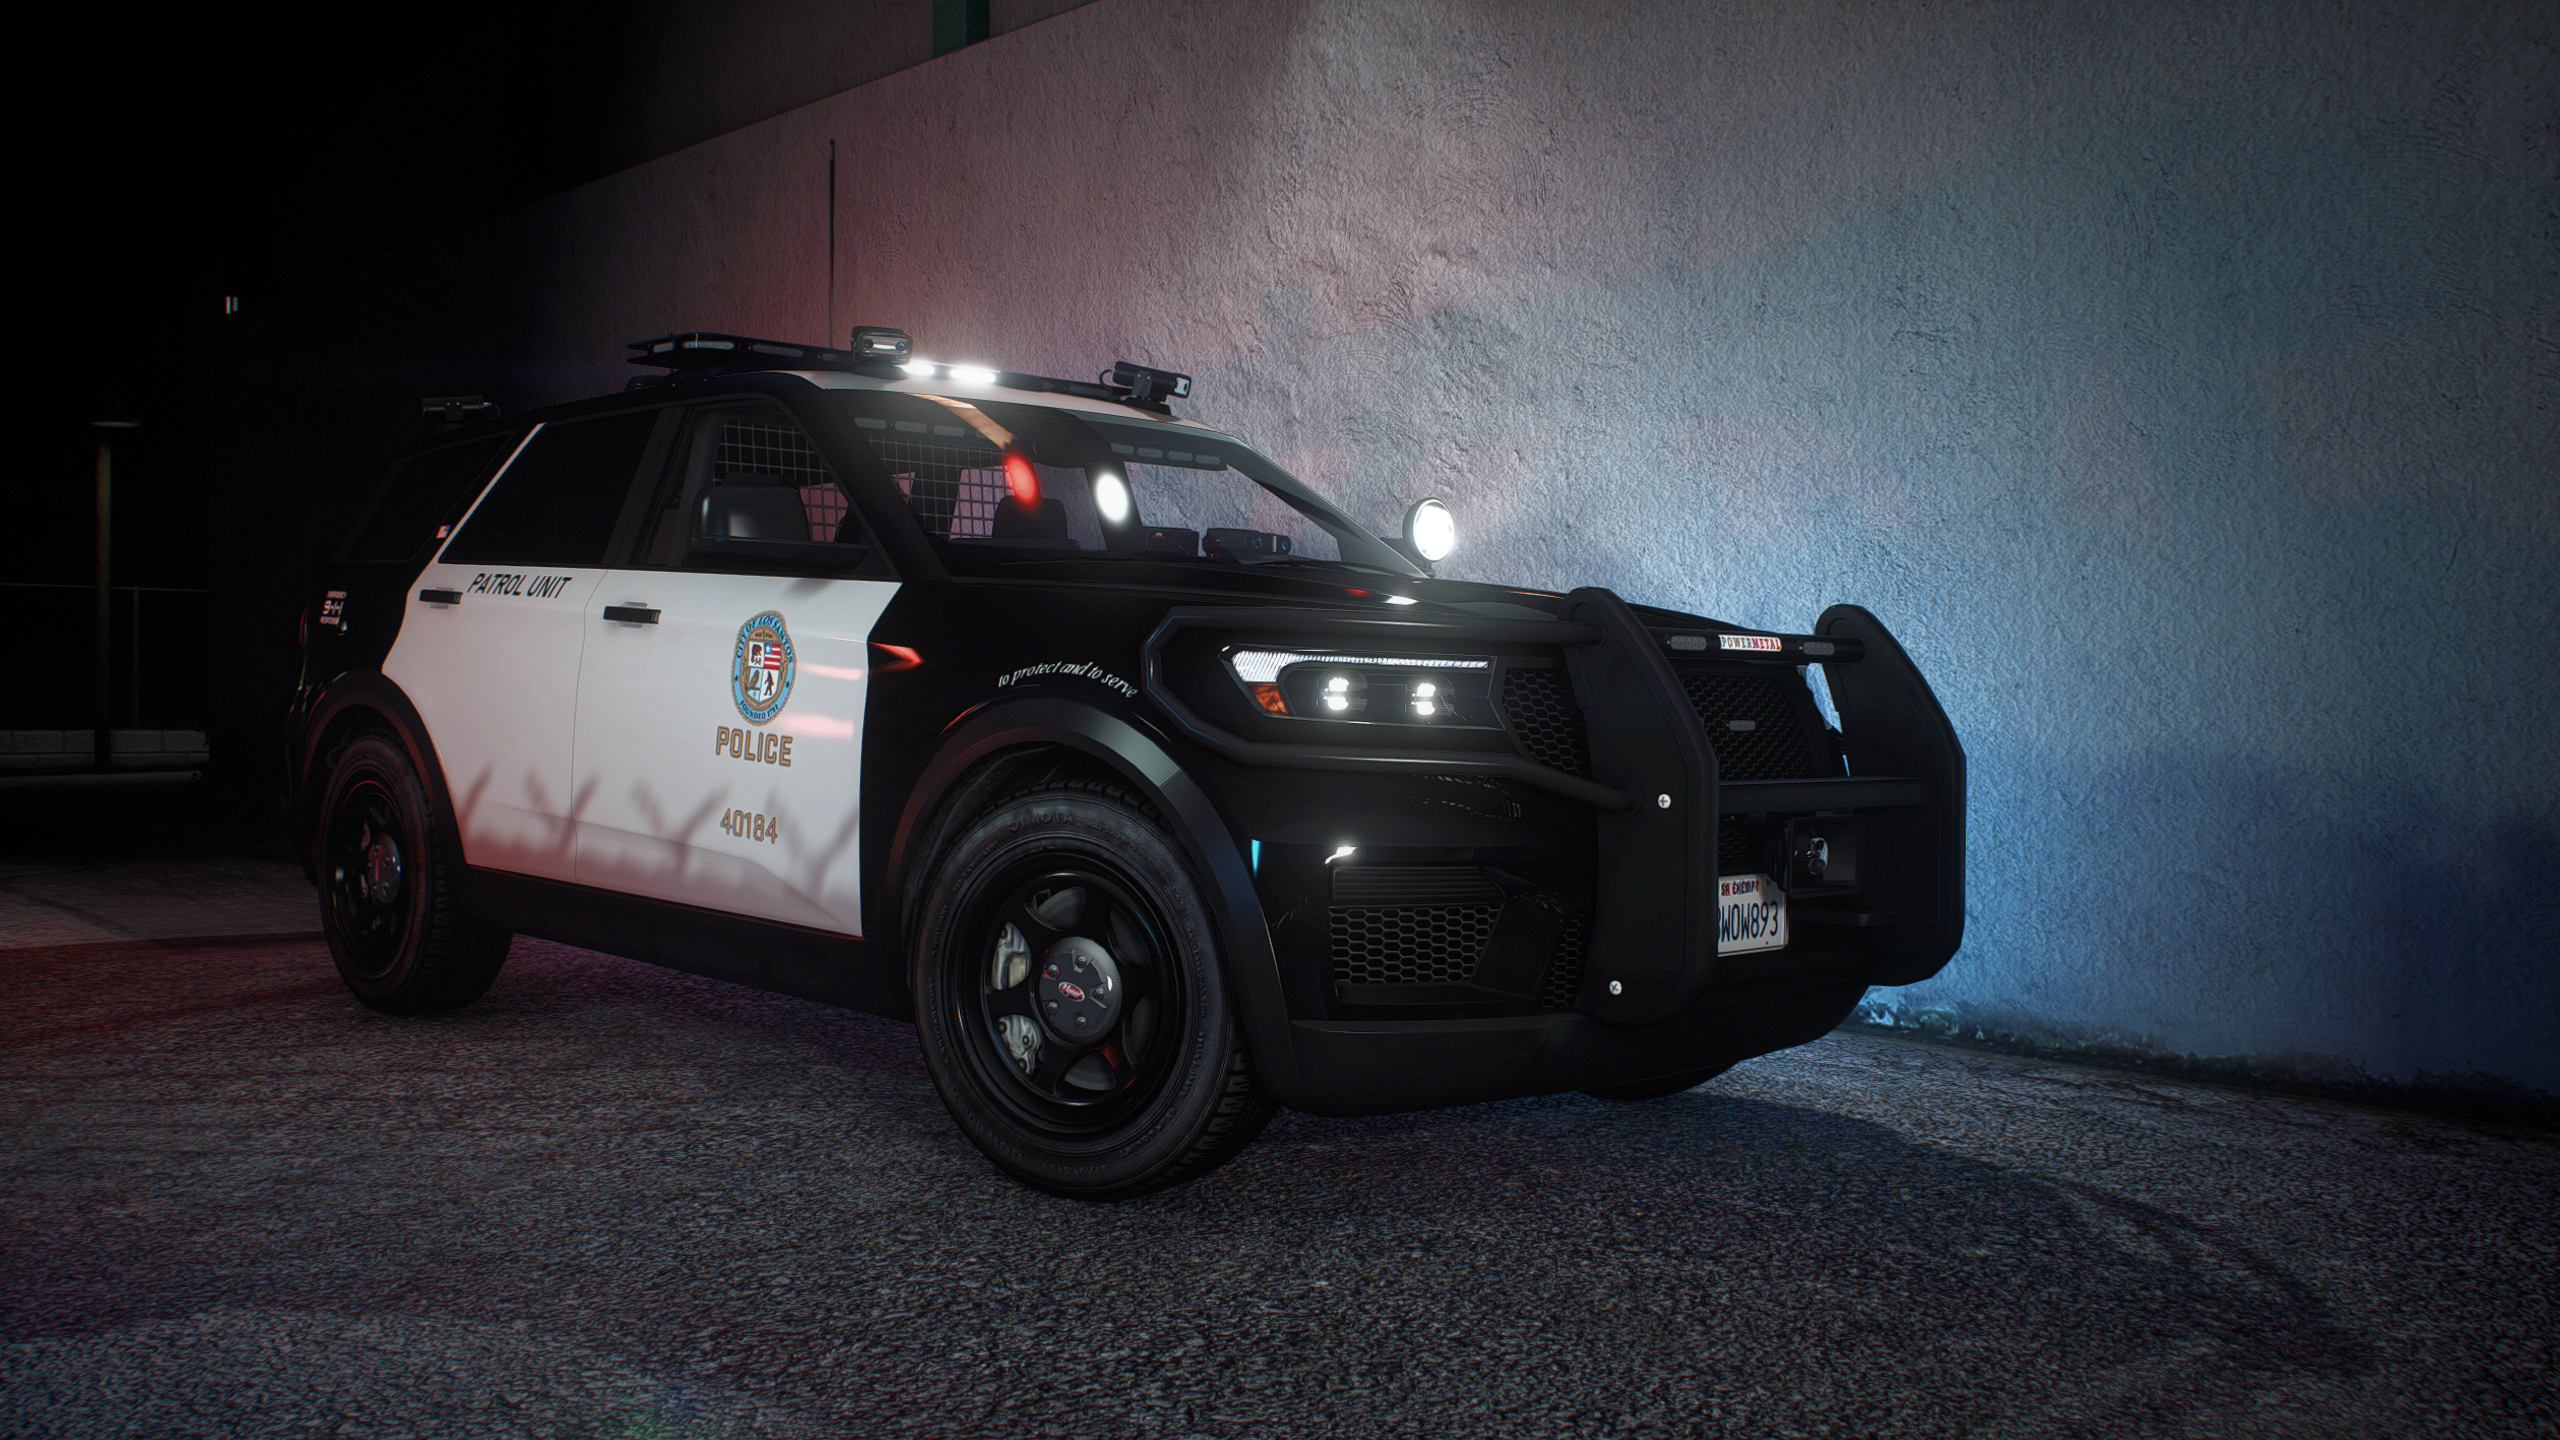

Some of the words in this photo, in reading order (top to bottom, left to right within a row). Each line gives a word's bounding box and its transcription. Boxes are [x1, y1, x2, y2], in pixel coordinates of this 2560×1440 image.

[466, 573, 527, 596] PATROL
[526, 575, 573, 598] UNIT
[737, 633, 747, 659] CITY
[745, 620, 756, 633] OF
[758, 615, 774, 625] LOS
[772, 619, 794, 663] SANTOS
[998, 674, 1010, 688] to
[1010, 661, 1062, 686] protect
[1059, 661, 1094, 676] and
[1087, 665, 1103, 679] to
[1101, 673, 1138, 698] serve
[740, 700, 766, 719] FOUNDED
[715, 726, 793, 767] POLICE
[720, 808, 778, 845] 40184
